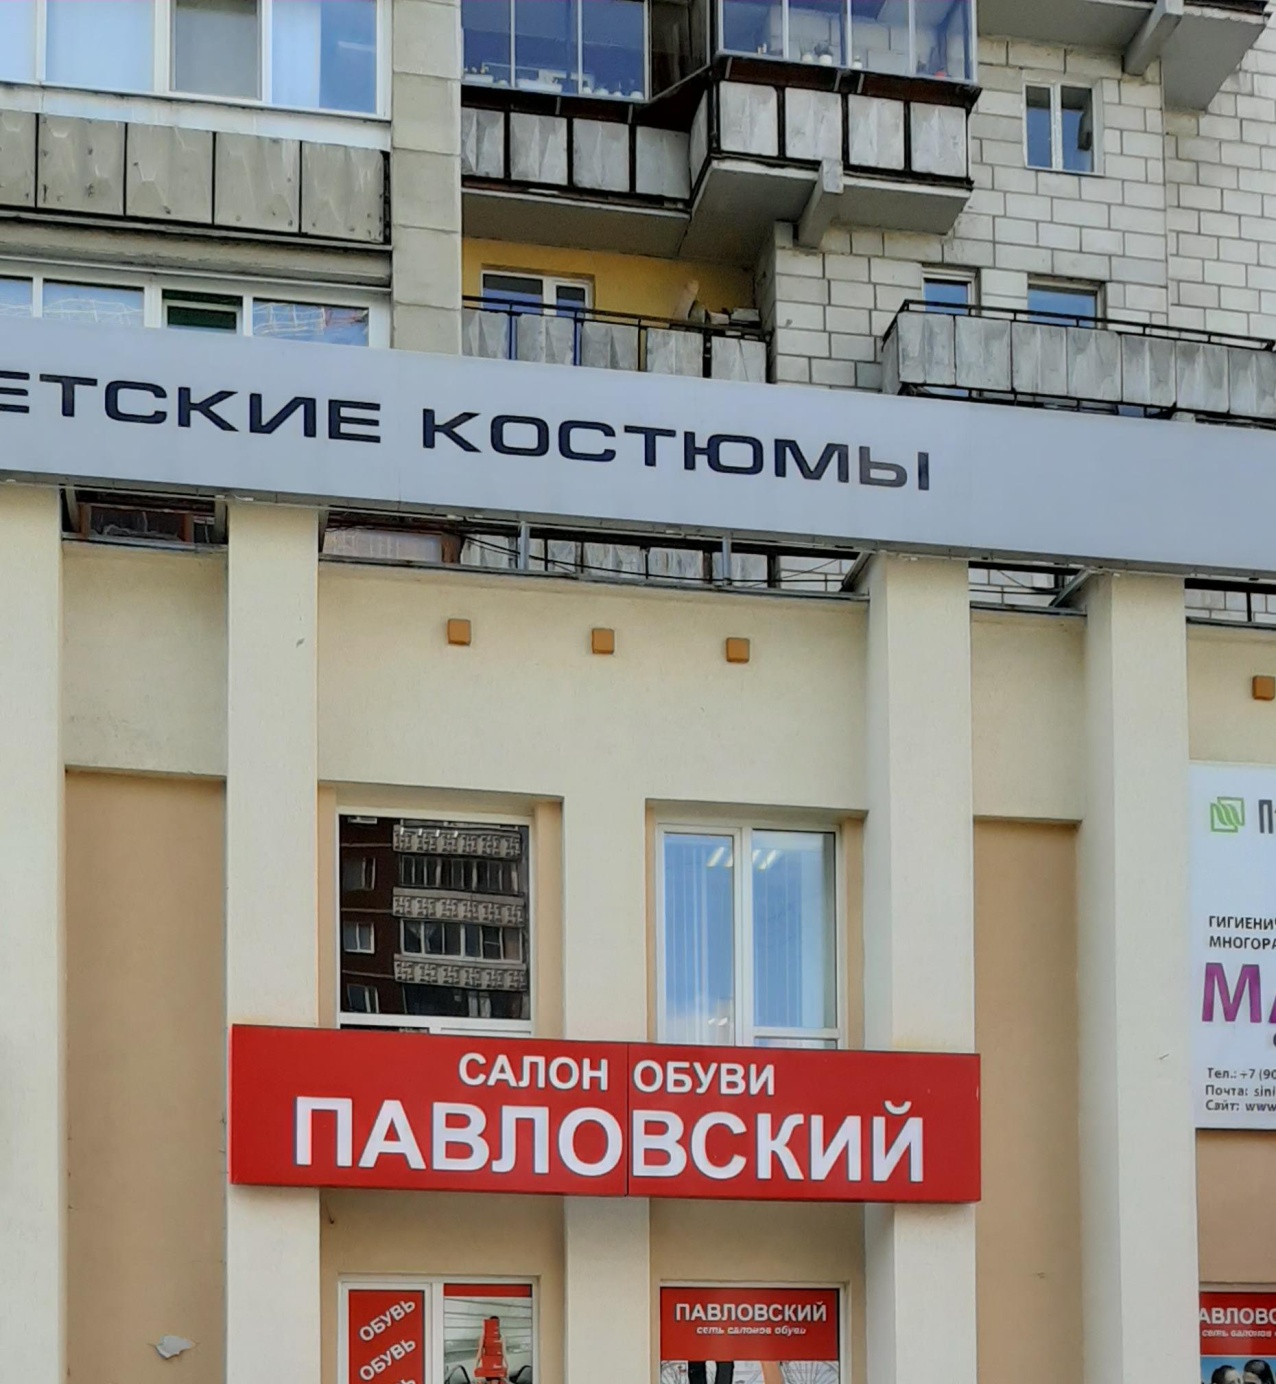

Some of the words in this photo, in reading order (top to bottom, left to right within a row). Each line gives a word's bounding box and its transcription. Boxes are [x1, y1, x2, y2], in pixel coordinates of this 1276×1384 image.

[422, 407, 930, 491] КОСТЮМЫ
[1209, 915, 1276, 931] ГИГИЕНИ
[458, 1052, 608, 1092] САЛОН
[633, 1059, 776, 1097] ОБУВИ
[1207, 1067, 1237, 1079] Тел.:
[1205, 1084, 1248, 1096] Почта:
[1205, 1099, 1240, 1111] Сайт:
[293, 1095, 925, 1184] ПАВЛОВСКИЙ
[359, 1300, 416, 1341] ОБУВЬ
[674, 1301, 827, 1322] ПАВЛОВСКИЙ
[696, 1326, 725, 1335] сеть
[359, 1339, 417, 1381] ОБУВЬ
